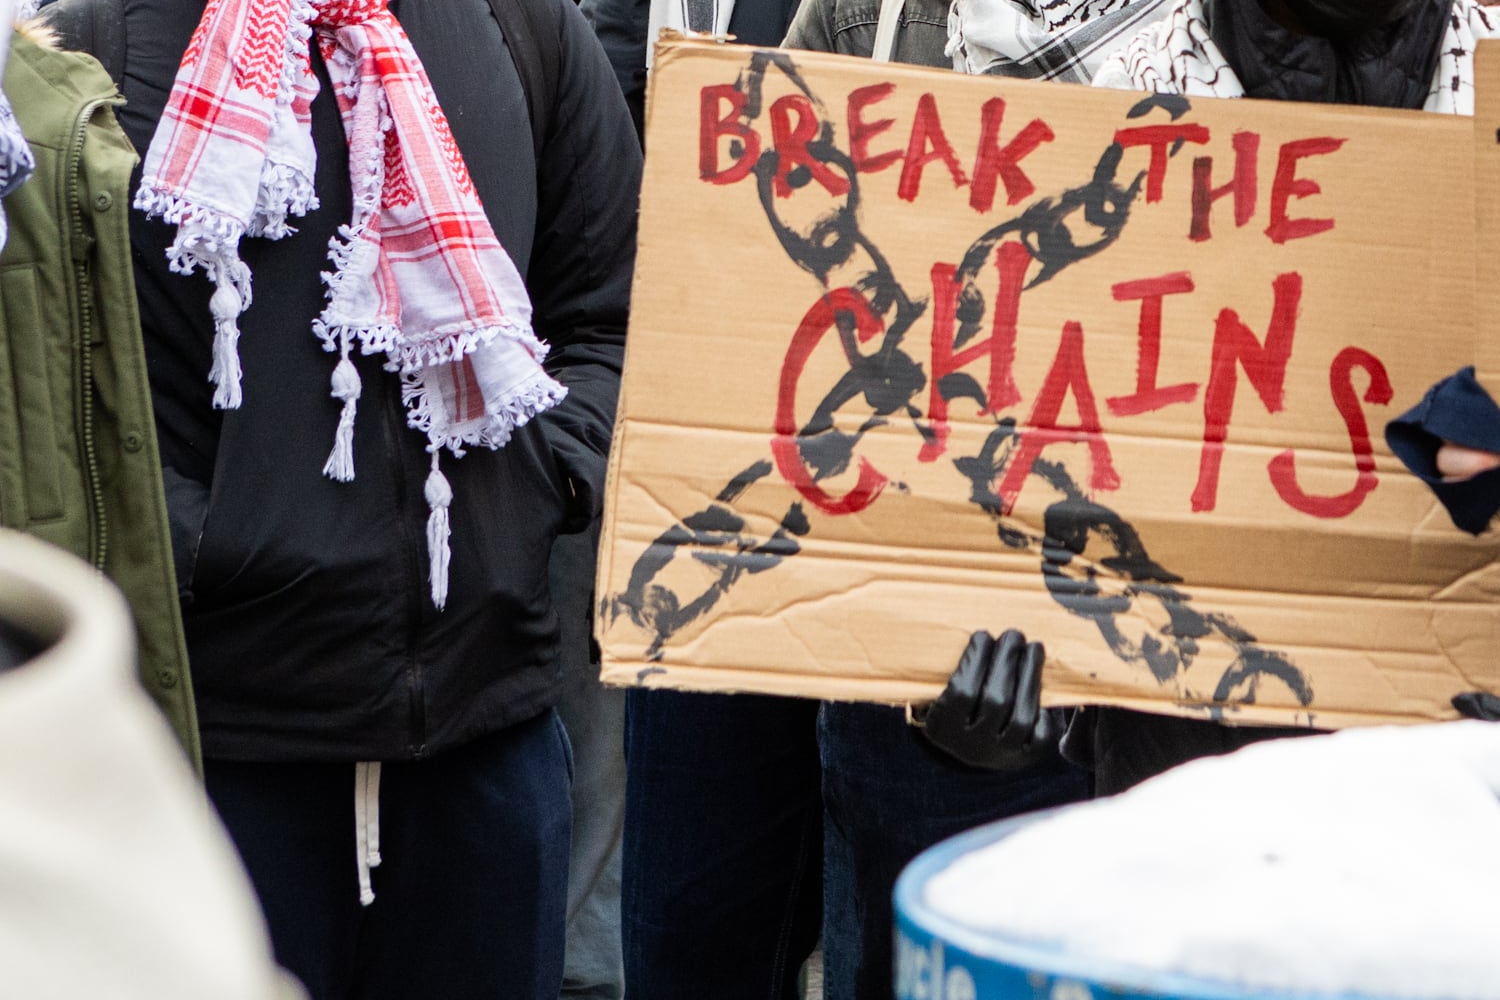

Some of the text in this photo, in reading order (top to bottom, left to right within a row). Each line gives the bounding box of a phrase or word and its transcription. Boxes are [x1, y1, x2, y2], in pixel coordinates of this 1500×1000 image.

[698, 81, 1348, 245] BREAK THE
[770, 240, 1394, 519] CHAINS
